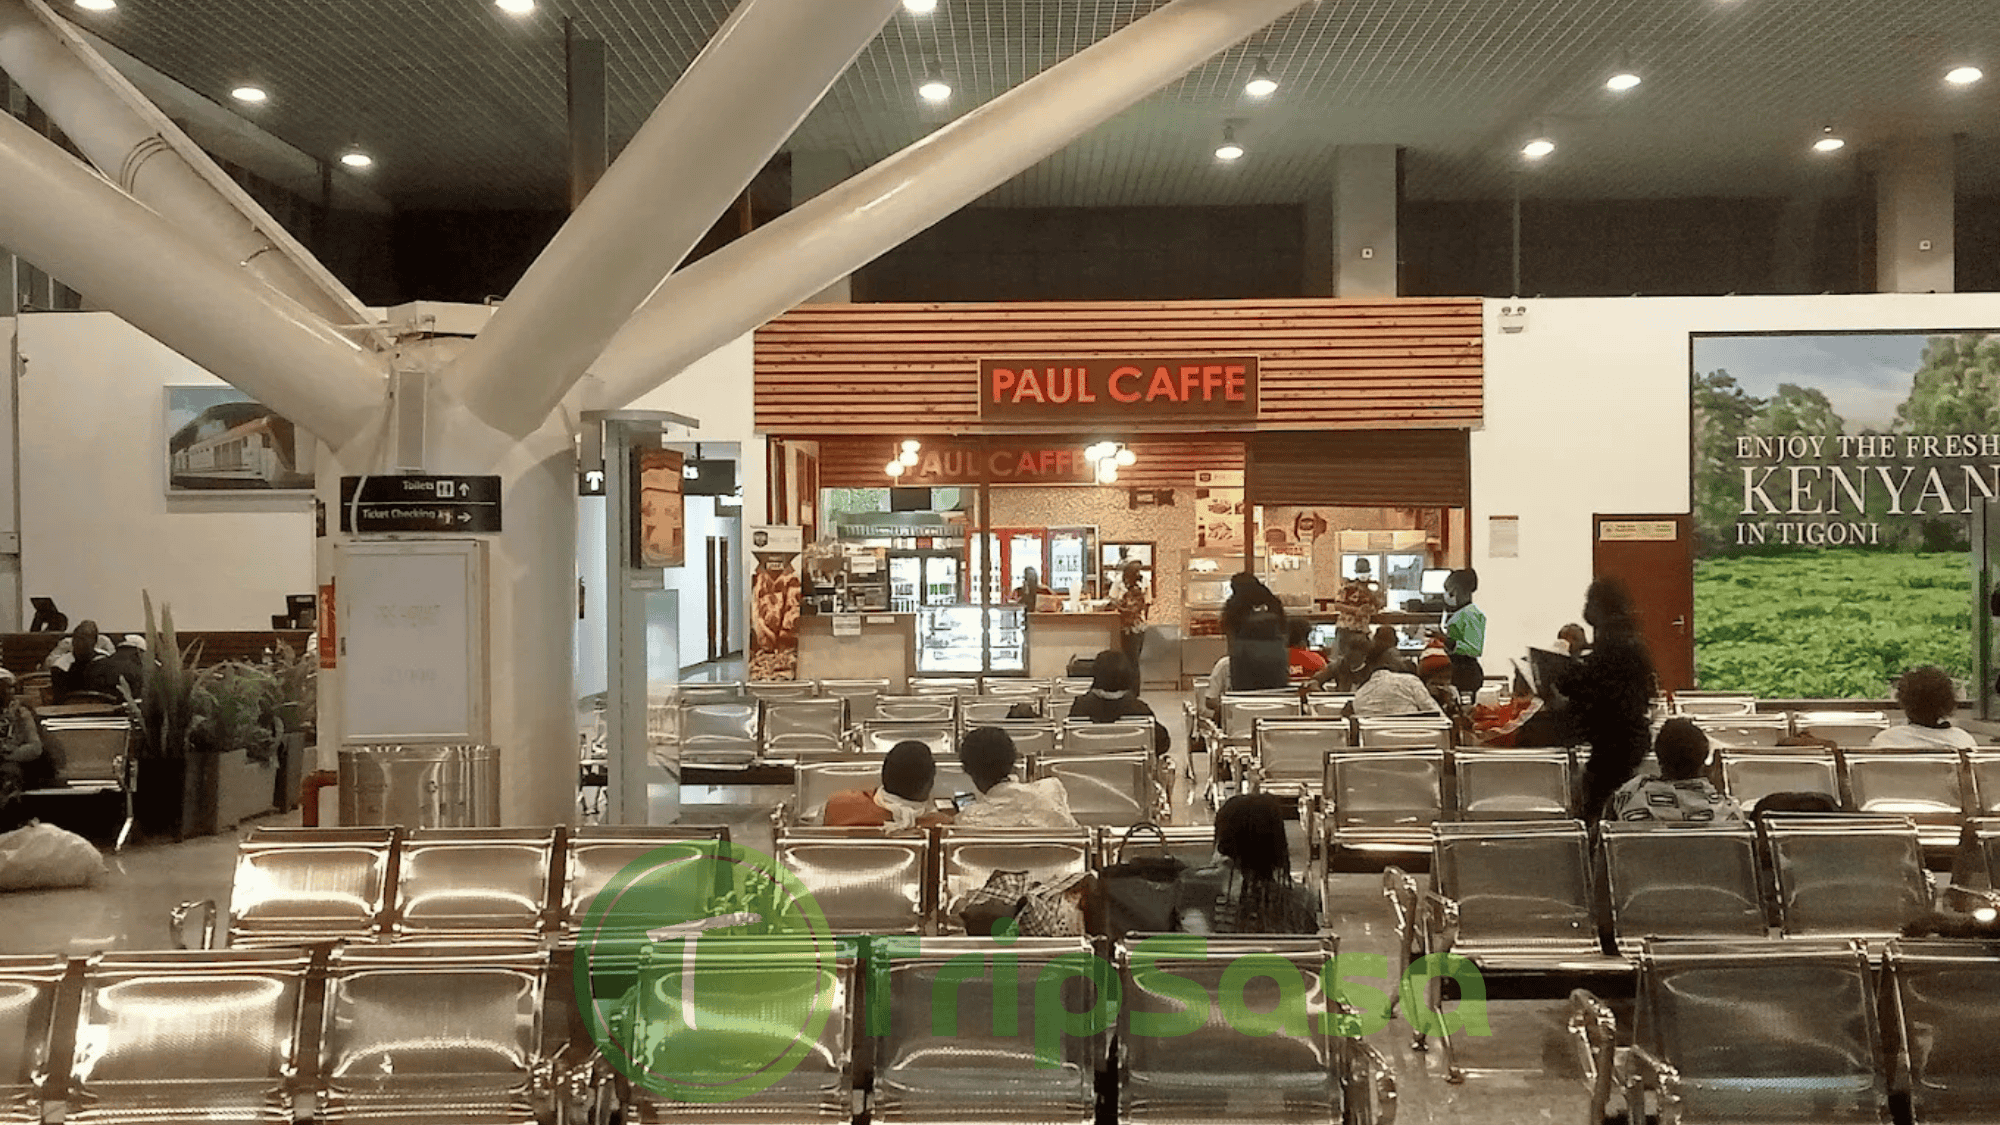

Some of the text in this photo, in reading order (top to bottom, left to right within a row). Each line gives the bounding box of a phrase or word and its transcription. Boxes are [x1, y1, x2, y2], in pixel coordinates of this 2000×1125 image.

[992, 366, 1246, 403] PAUL CAFFE
[1736, 434, 2000, 463] ENJOY THE FRESH
[988, 449, 1086, 476] CAFFE
[402, 480, 435, 491] Toilets
[1739, 465, 2000, 516] KENYAN
[362, 507, 436, 520] Ticket Checking
[1736, 522, 1880, 545] IN TIGONI
